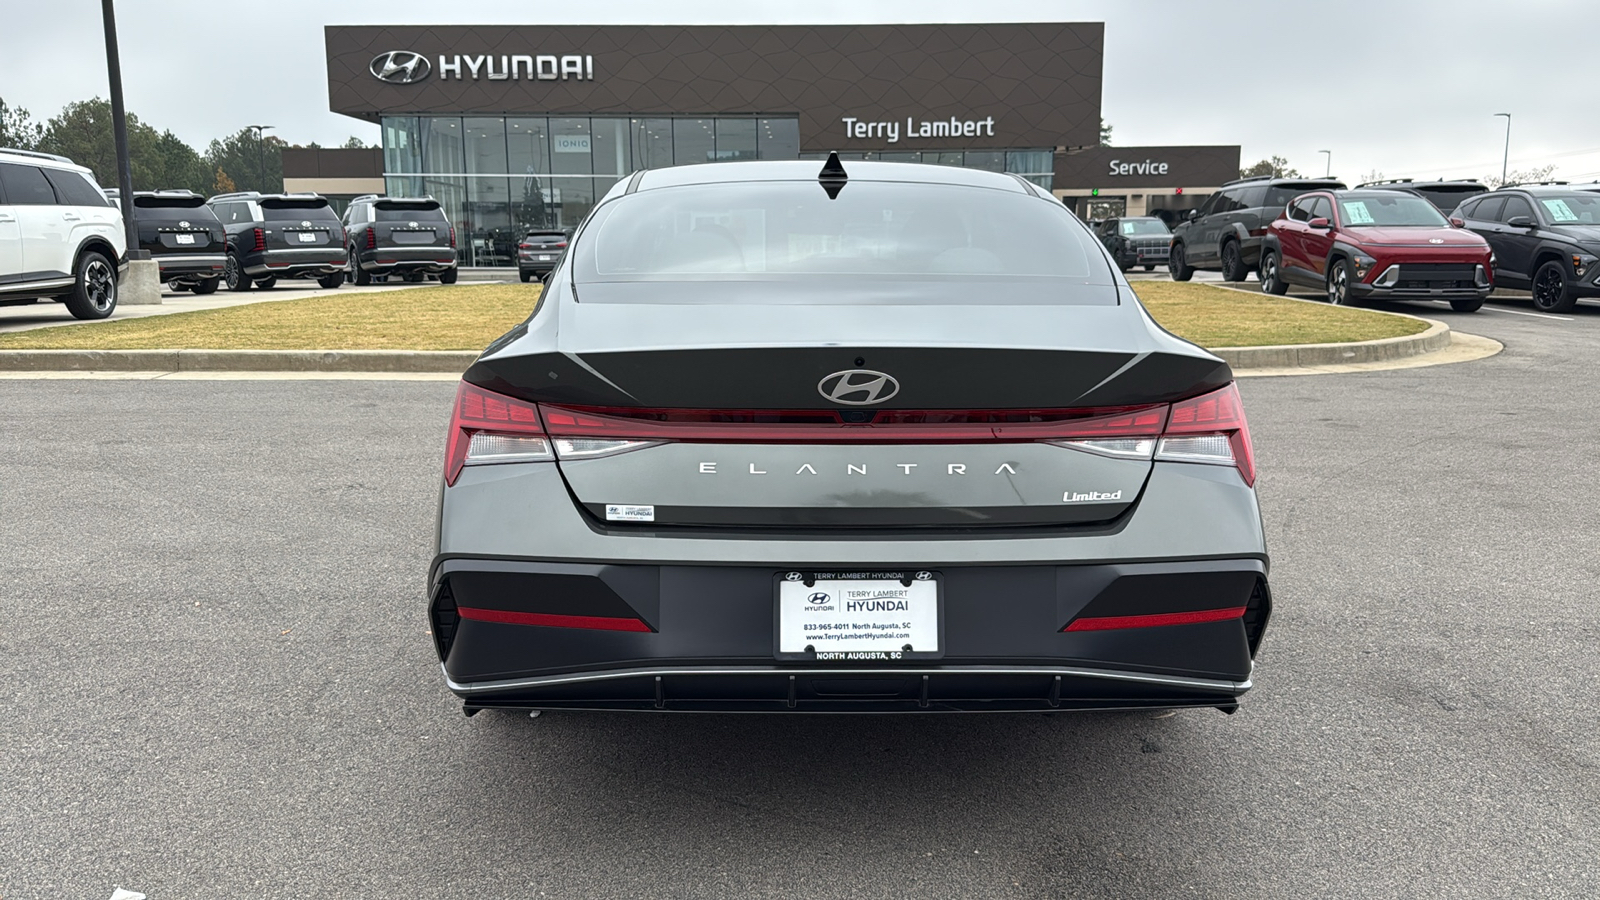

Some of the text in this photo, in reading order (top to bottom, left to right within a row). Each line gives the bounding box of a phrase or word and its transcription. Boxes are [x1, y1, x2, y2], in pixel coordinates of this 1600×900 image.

[439, 54, 594, 81] HYUNDAI
[842, 116, 994, 143] Terry Lambert
[1109, 159, 1168, 176] Service
[699, 462, 1016, 475] ELANTRA
[1063, 490, 1122, 502] Limited
[847, 601, 908, 611] HYUNDAI
[806, 632, 910, 641] www.TerryLambertHyundai.com
